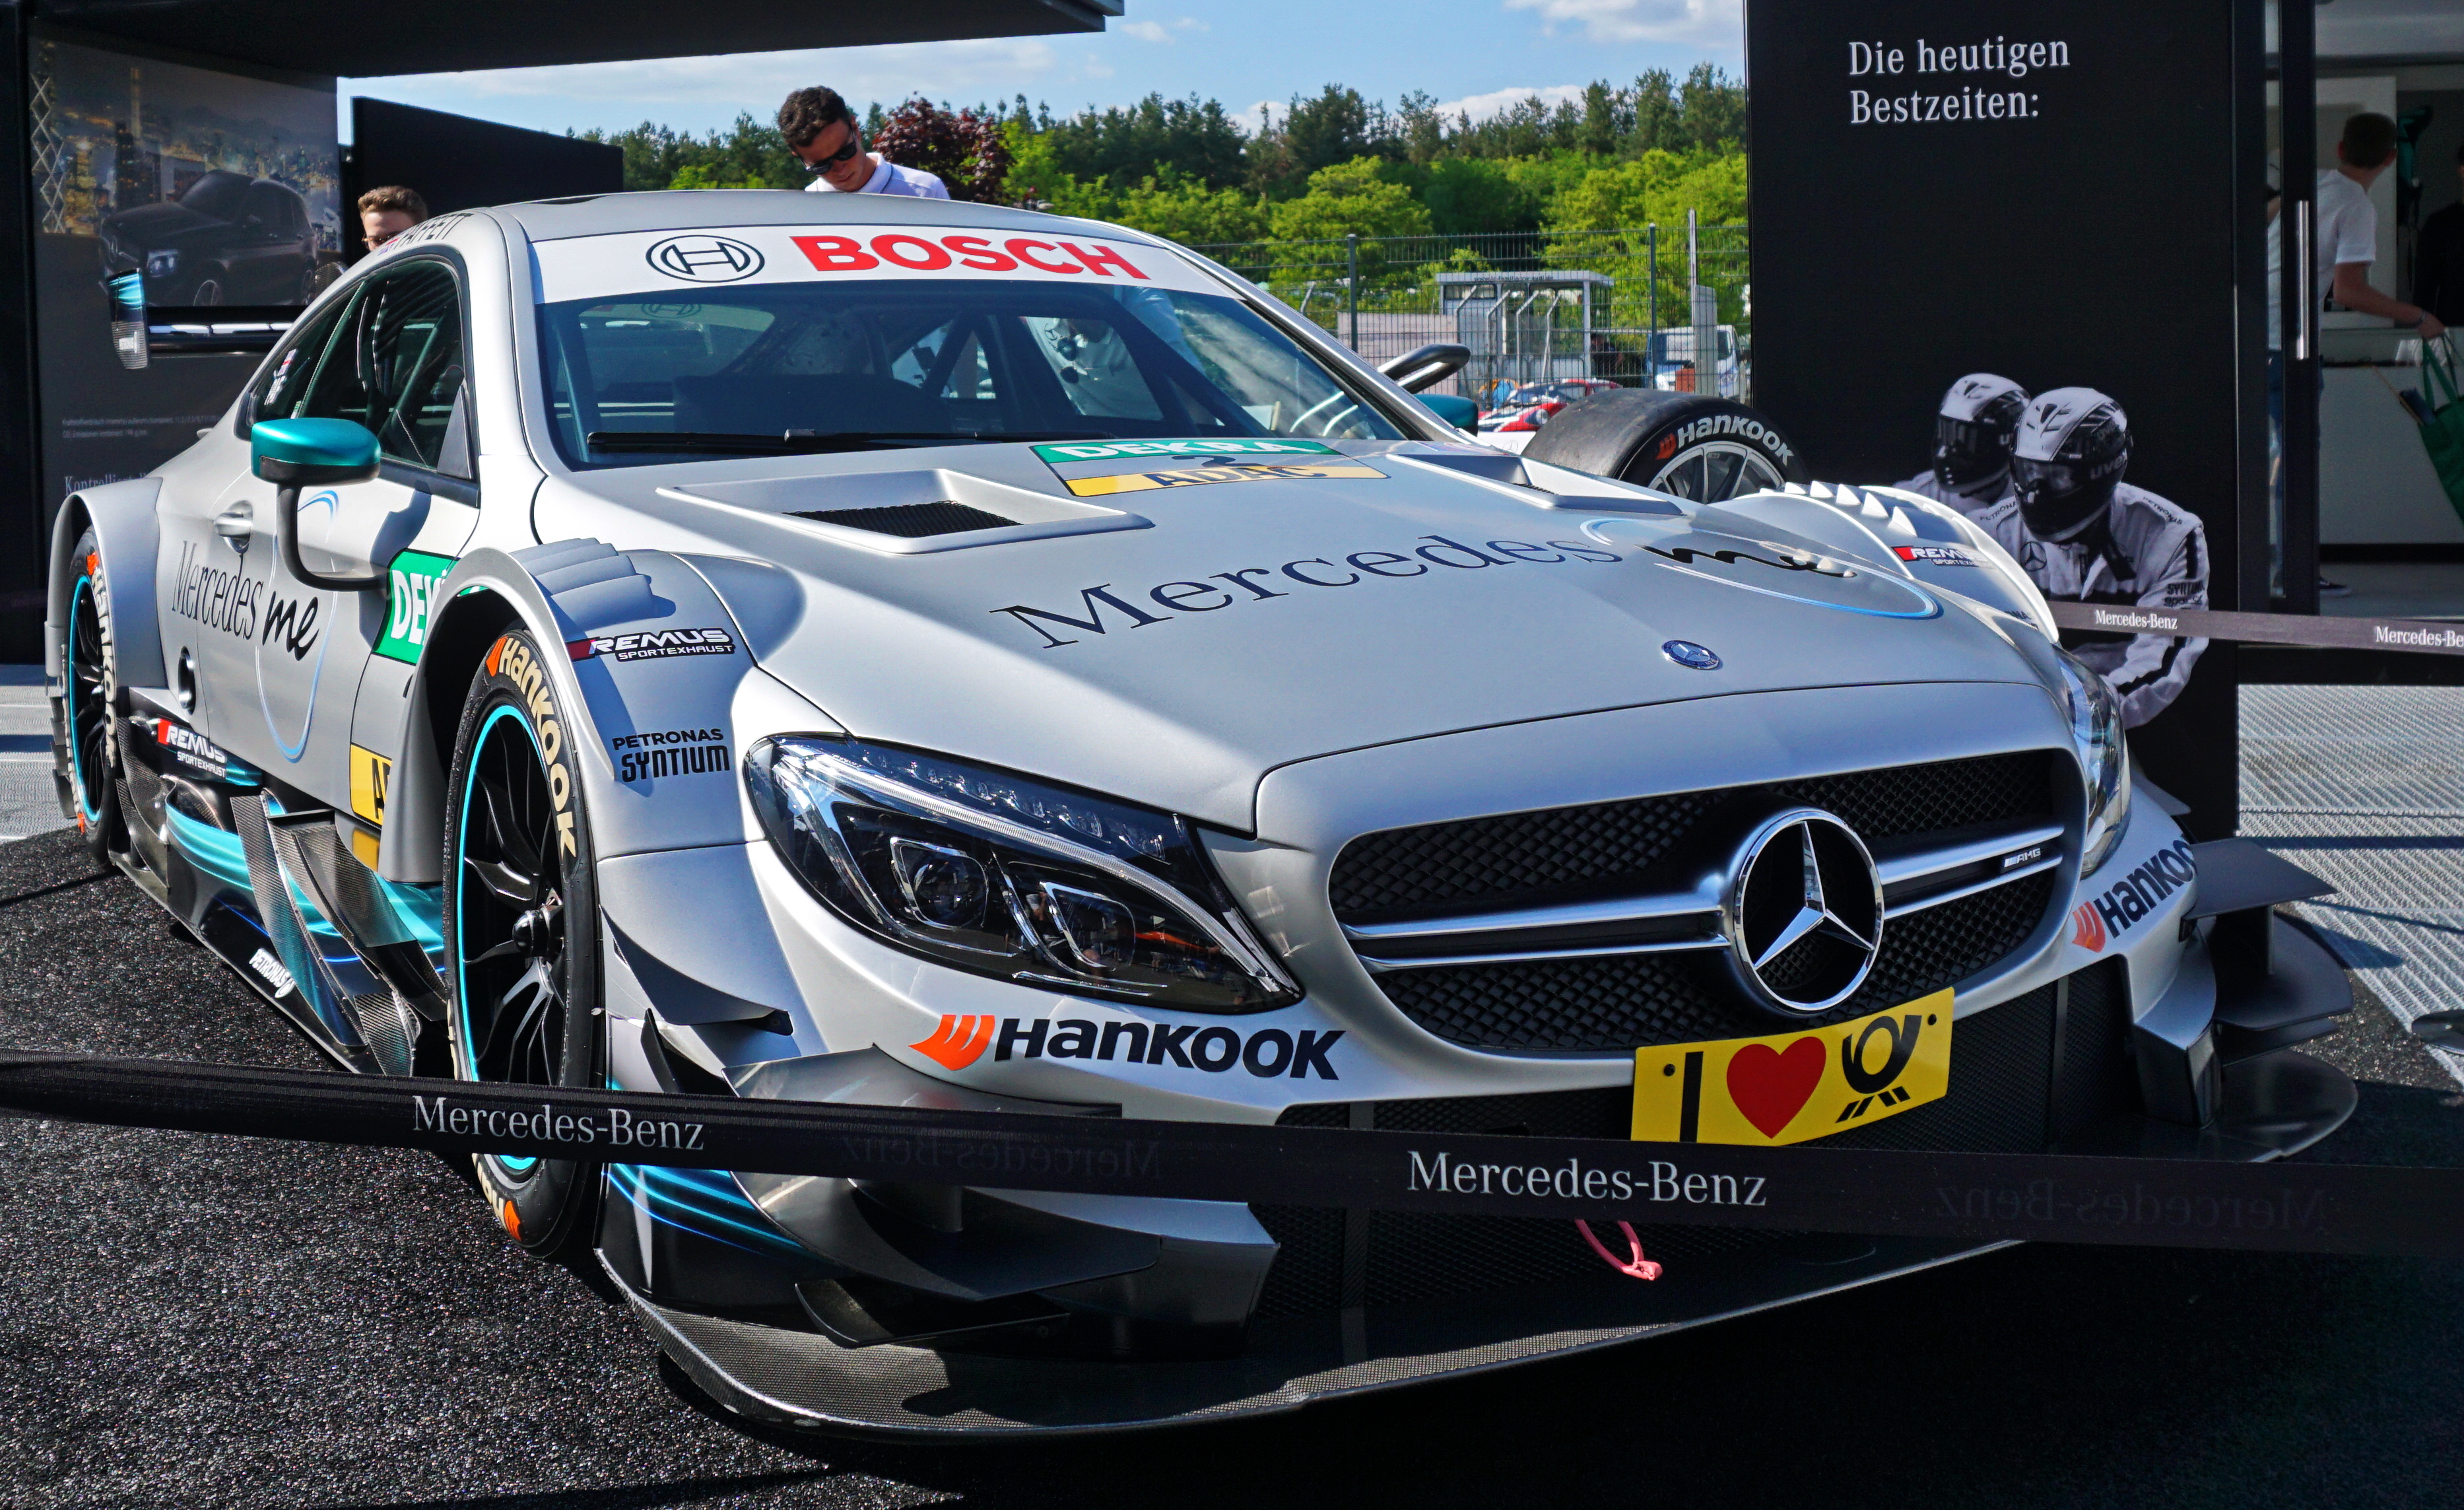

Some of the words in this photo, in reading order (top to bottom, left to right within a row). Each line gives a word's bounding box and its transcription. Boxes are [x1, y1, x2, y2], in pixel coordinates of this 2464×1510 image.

[1849, 41, 1904, 75] Die
[1917, 36, 2071, 77] heutigen
[1850, 86, 2039, 123] Bestzeiten:
[789, 234, 1150, 280] BOSCH
[1049, 441, 1310, 460] DEKRA
[1677, 415, 1794, 467] Hankook
[1145, 466, 1327, 487] ADAC
[172, 541, 263, 640] Mercedes
[263, 594, 319, 660] me
[990, 535, 1622, 648] Mercedes
[2094, 609, 2178, 629] Mercedes-Benz
[589, 630, 729, 654] REMUS
[618, 645, 733, 660] SPORTEXHAUST
[166, 725, 227, 763] REMUS
[498, 636, 577, 858] Hankook
[612, 728, 724, 750] PETRONAS
[177, 751, 226, 778] SPORTEXHAUST
[621, 745, 730, 782] SYNTIUM
[2016, 848, 2041, 864] AMG
[249, 948, 290, 988] PETRONAS
[994, 1017, 1346, 1080] Hankook
[1680, 1051, 1704, 1143] I
[412, 1095, 704, 1150] Mercedes-Benz
[1407, 1150, 1767, 1206] Mercedes-Benz
